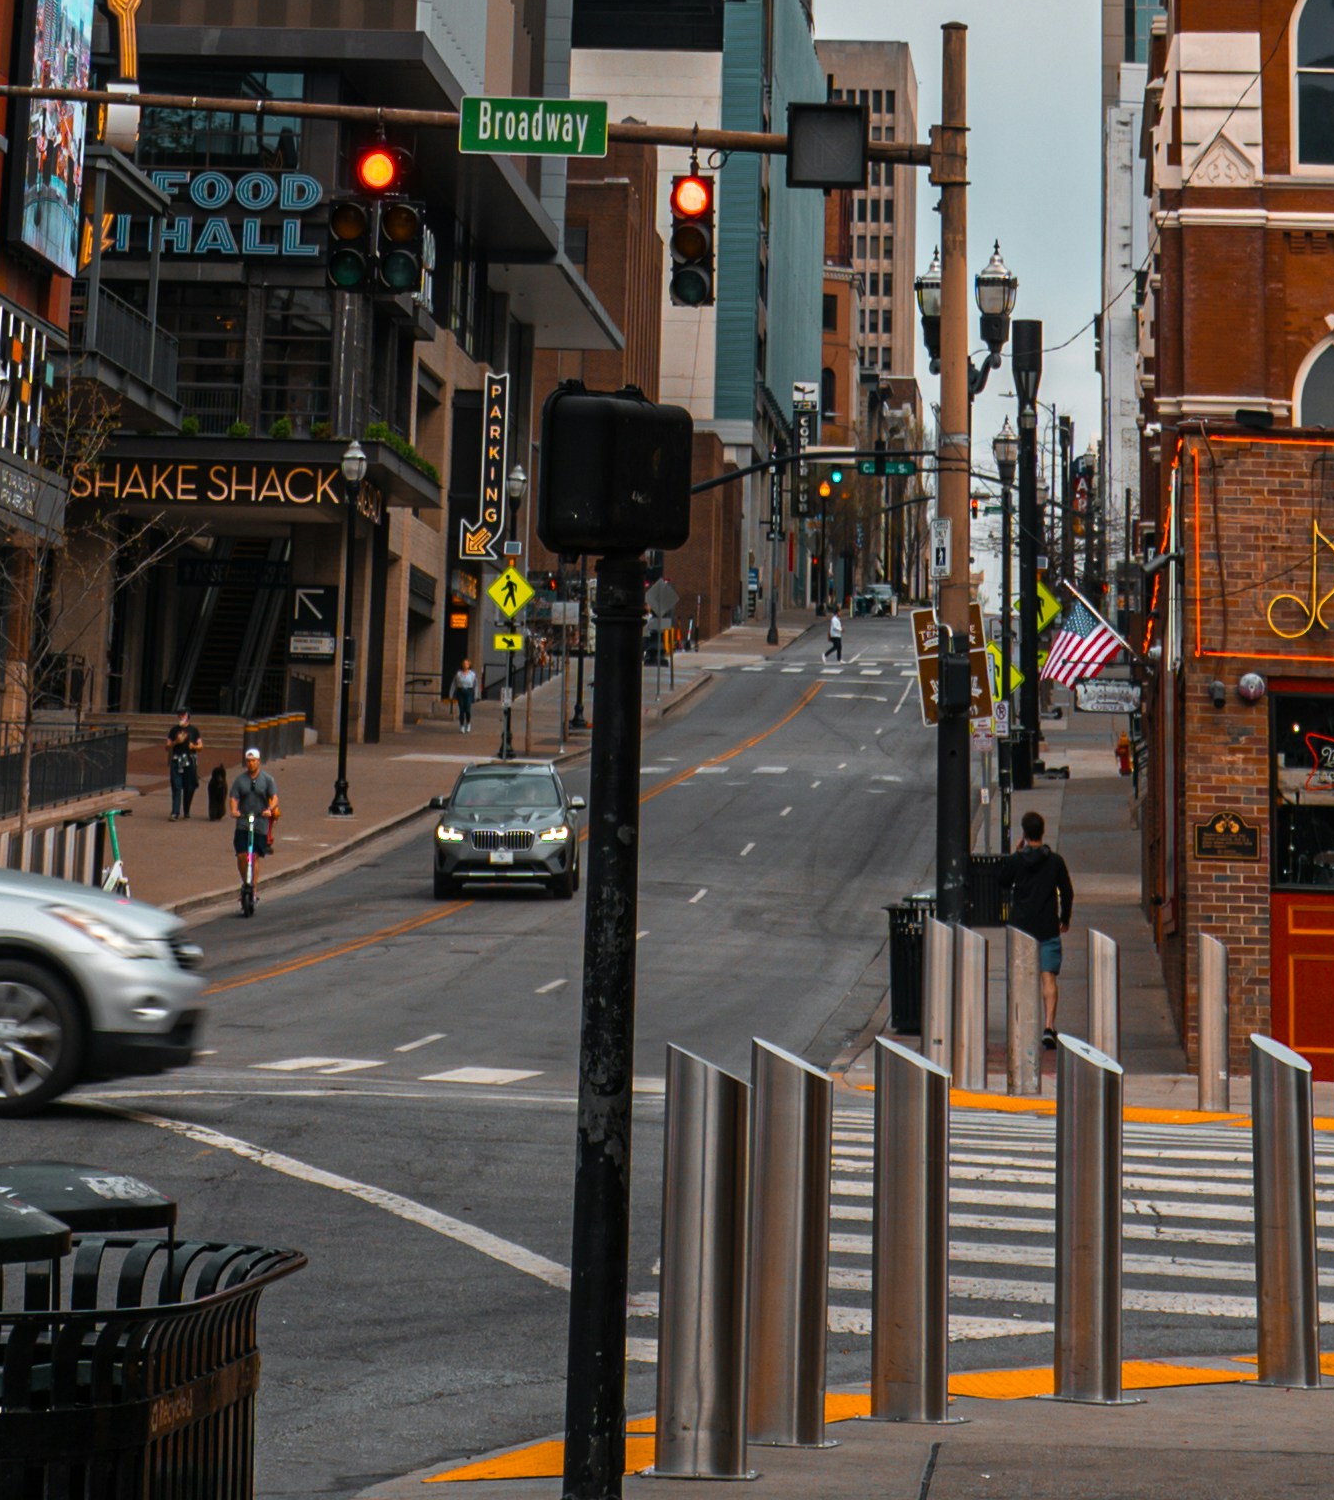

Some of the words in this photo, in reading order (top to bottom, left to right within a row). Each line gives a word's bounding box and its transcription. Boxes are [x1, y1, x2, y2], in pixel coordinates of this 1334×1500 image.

[478, 101, 588, 153] Broadway
[151, 170, 323, 211] FOOD
[484, 385, 502, 523] PARKING
[71, 463, 199, 500] SHAKE
[206, 465, 340, 504] SHACK
